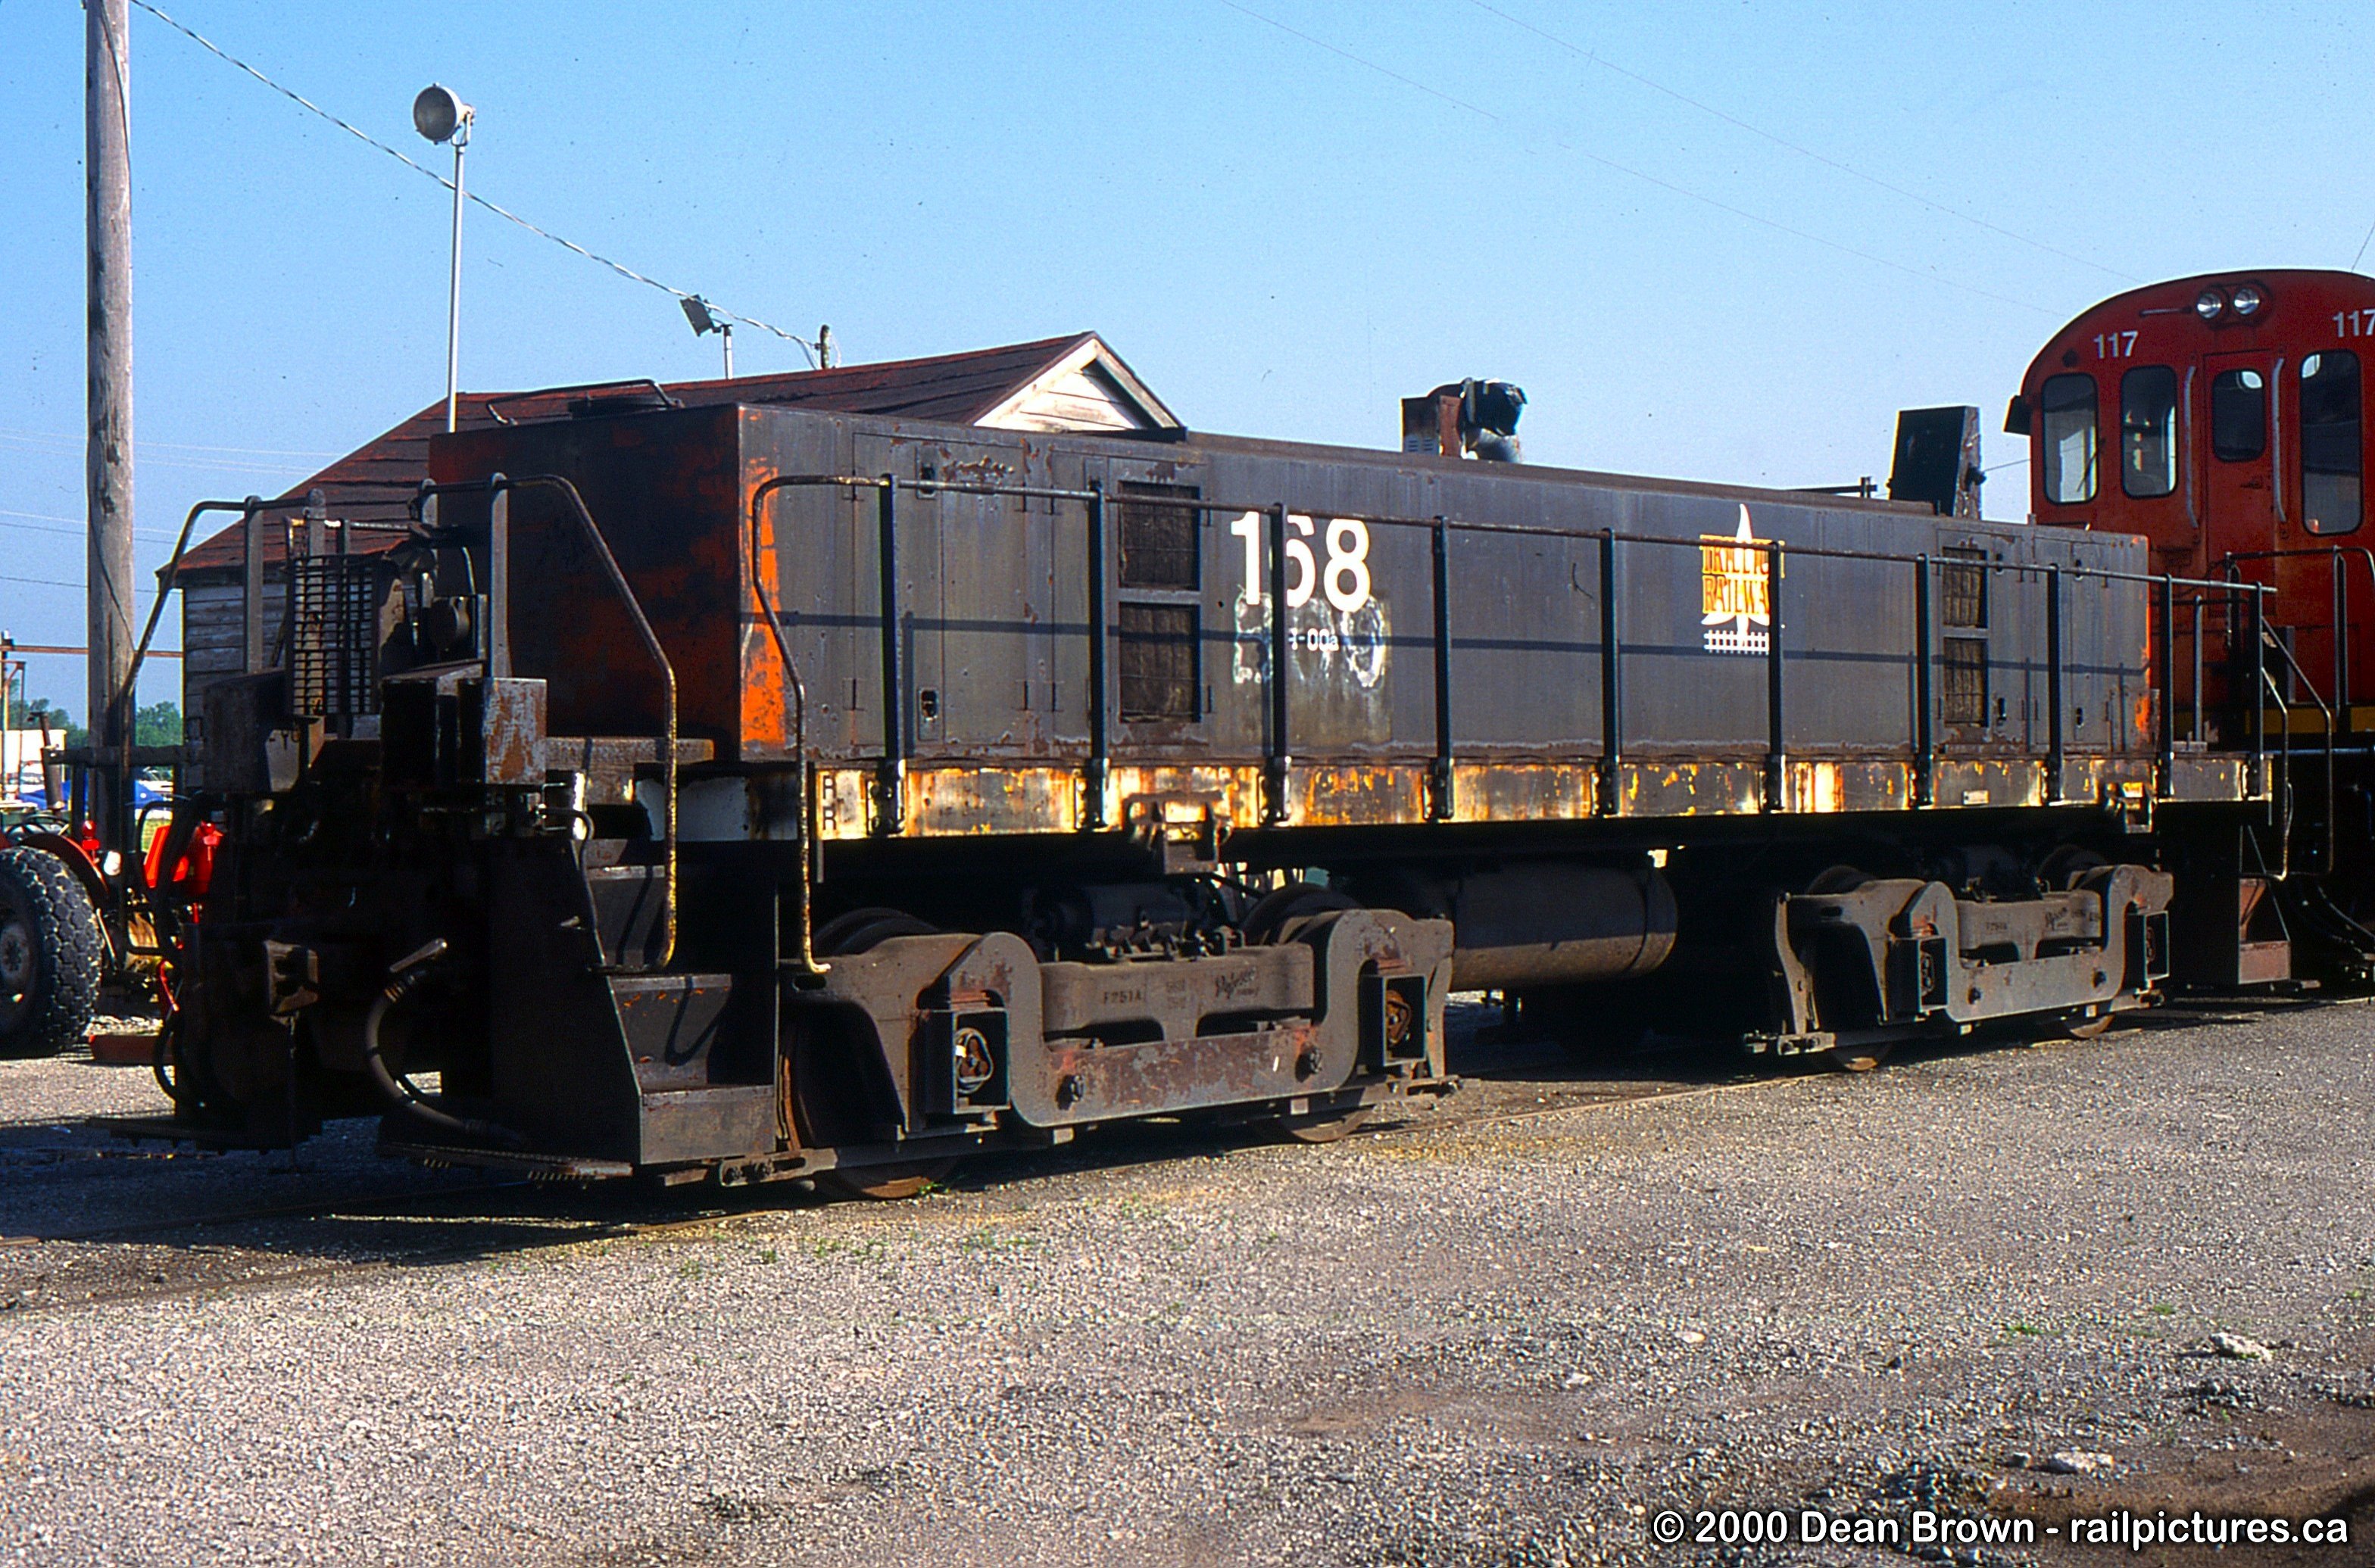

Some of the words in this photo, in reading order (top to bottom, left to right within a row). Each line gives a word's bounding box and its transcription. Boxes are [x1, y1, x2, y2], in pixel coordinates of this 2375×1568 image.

[2333, 309, 2375, 338] 117
[2093, 331, 2139, 359] 117
[1231, 511, 1371, 612] 168
[1702, 575, 1771, 616] RAILWA
